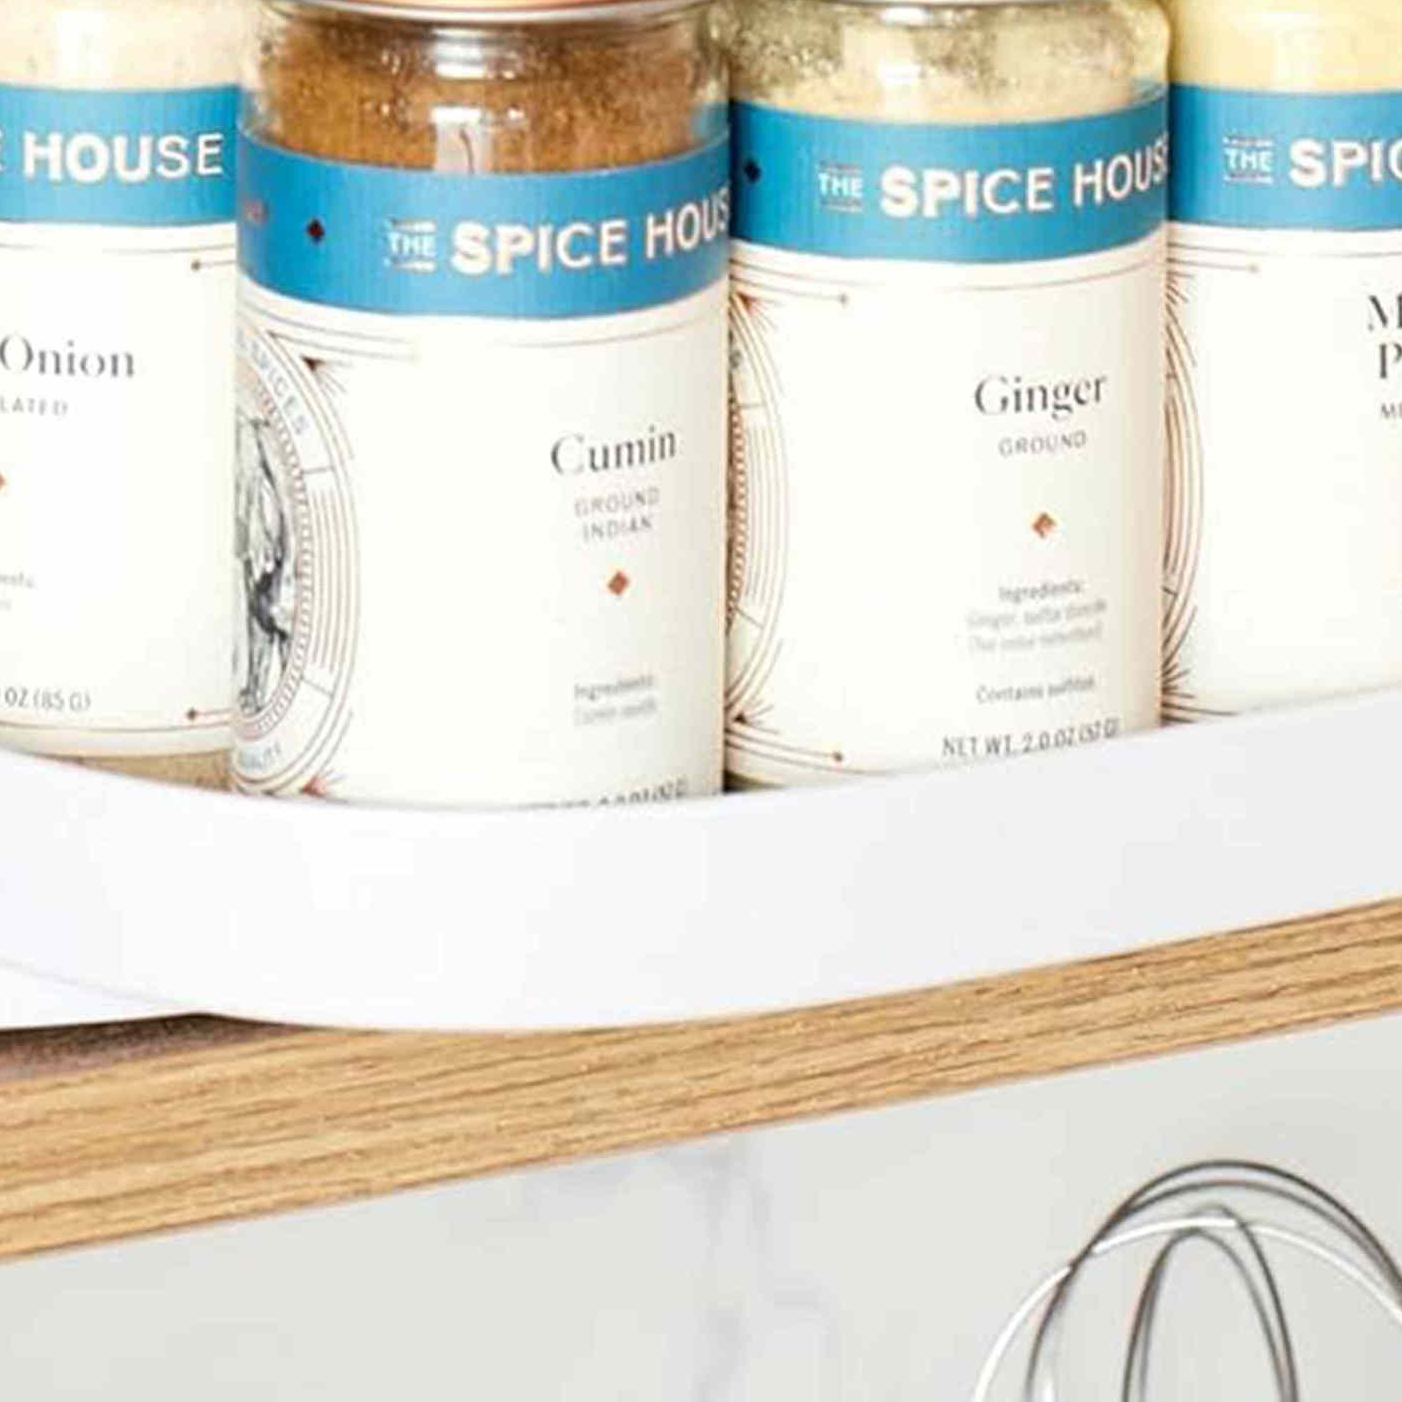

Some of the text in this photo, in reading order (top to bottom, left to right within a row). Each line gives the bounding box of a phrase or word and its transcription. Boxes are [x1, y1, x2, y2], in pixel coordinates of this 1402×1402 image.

[23, 131, 225, 184] HOUSE
[1224, 148, 1275, 173] THE
[817, 171, 864, 198] THE
[880, 164, 1055, 220] SPICE
[390, 230, 438, 258] THE
[450, 218, 628, 276] SPICE
[973, 372, 1108, 422] Ginger
[549, 424, 678, 476] Cumin
[998, 430, 1088, 458] GROUND
[573, 487, 661, 518] GROUND
[582, 515, 654, 543] INDIAN
[4, 685, 29, 708] OZ
